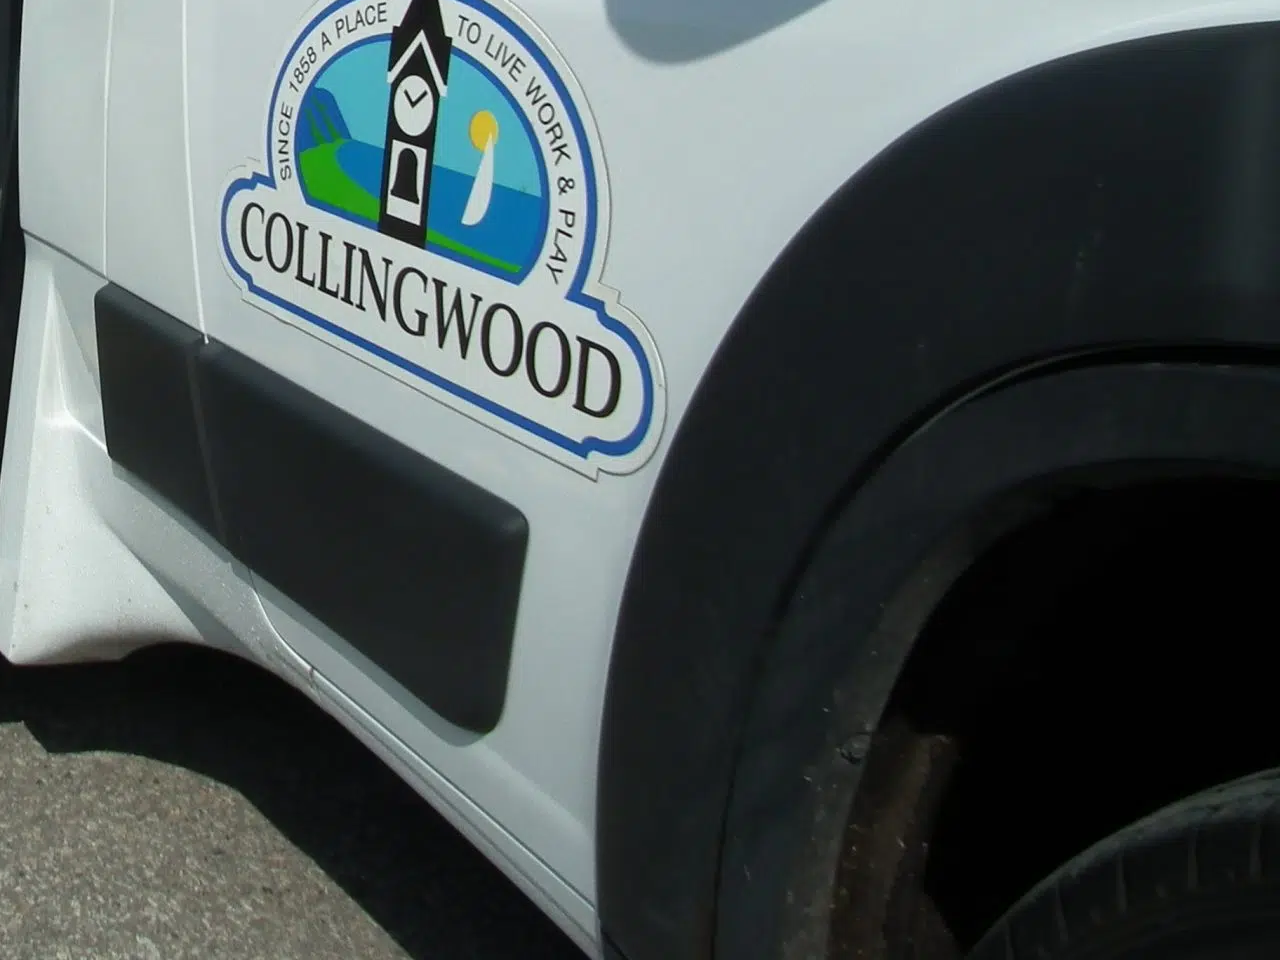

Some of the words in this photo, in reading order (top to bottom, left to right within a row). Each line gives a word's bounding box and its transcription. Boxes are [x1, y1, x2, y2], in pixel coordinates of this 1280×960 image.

[320, 31, 332, 52] A
[335, 2, 388, 39] PLACE
[458, 14, 482, 45] TO
[288, 46, 317, 93] 1858
[484, 34, 526, 82] LIVE
[278, 102, 293, 181] SINCE
[525, 76, 571, 165] WORK
[557, 177, 575, 195] &
[546, 208, 575, 284] PLAY
[241, 201, 622, 419] COLLINGWOOD
